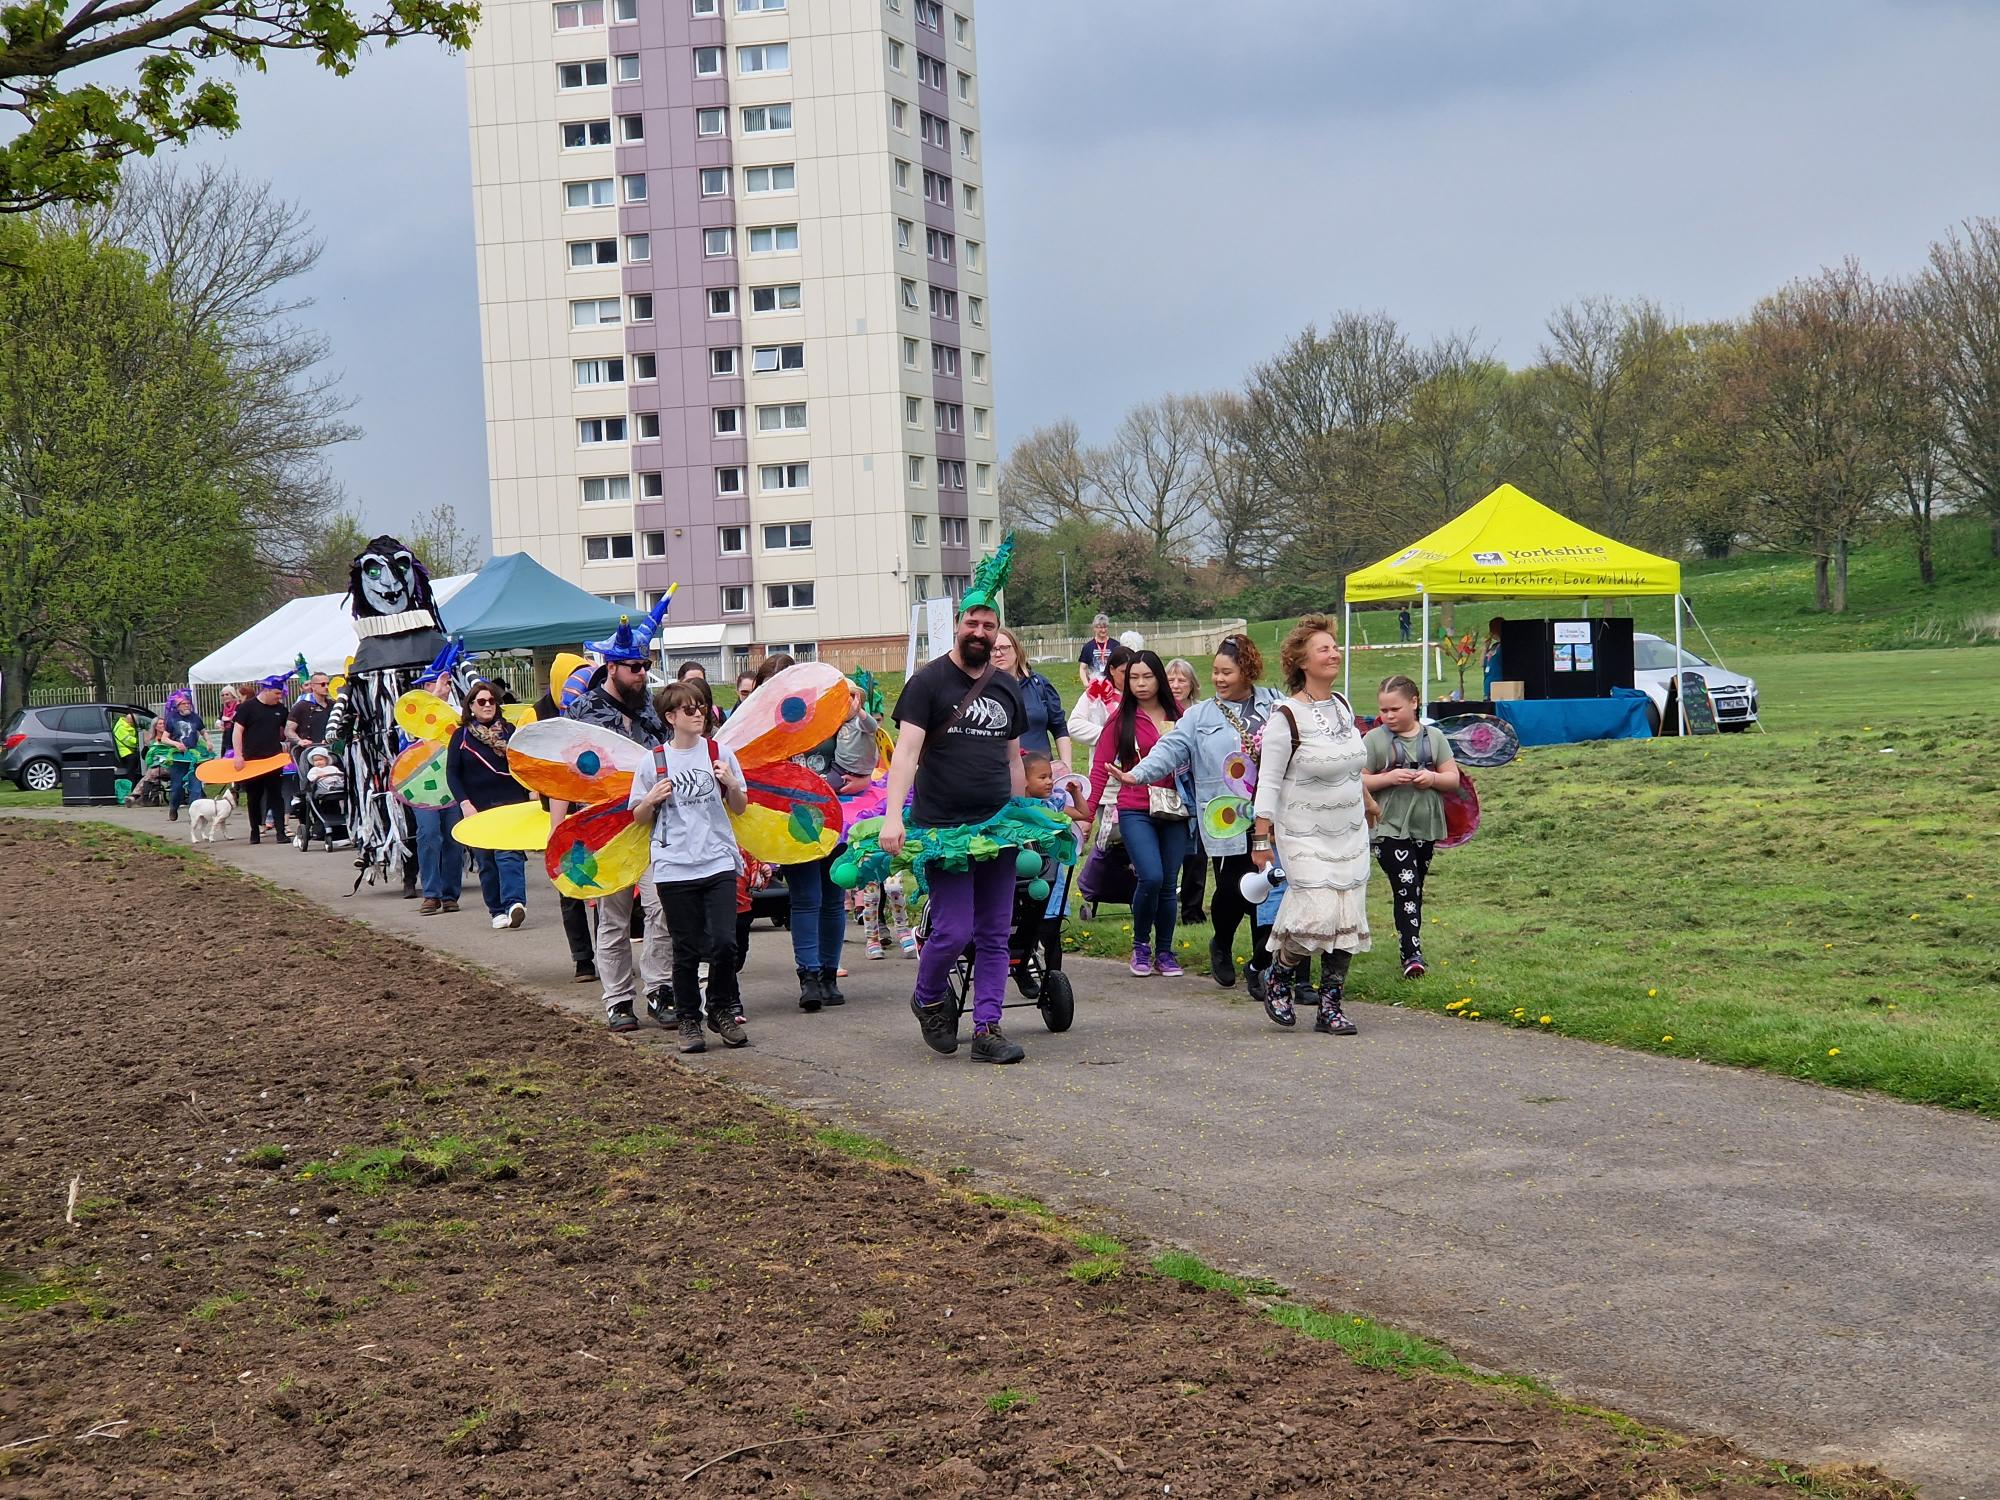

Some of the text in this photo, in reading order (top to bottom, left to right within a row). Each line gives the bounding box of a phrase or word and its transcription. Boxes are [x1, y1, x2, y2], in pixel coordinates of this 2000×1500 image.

[1507, 546, 1604, 558] Yorkshire
[1459, 571, 1647, 586] Love Yorkshire, Love Wildlife
